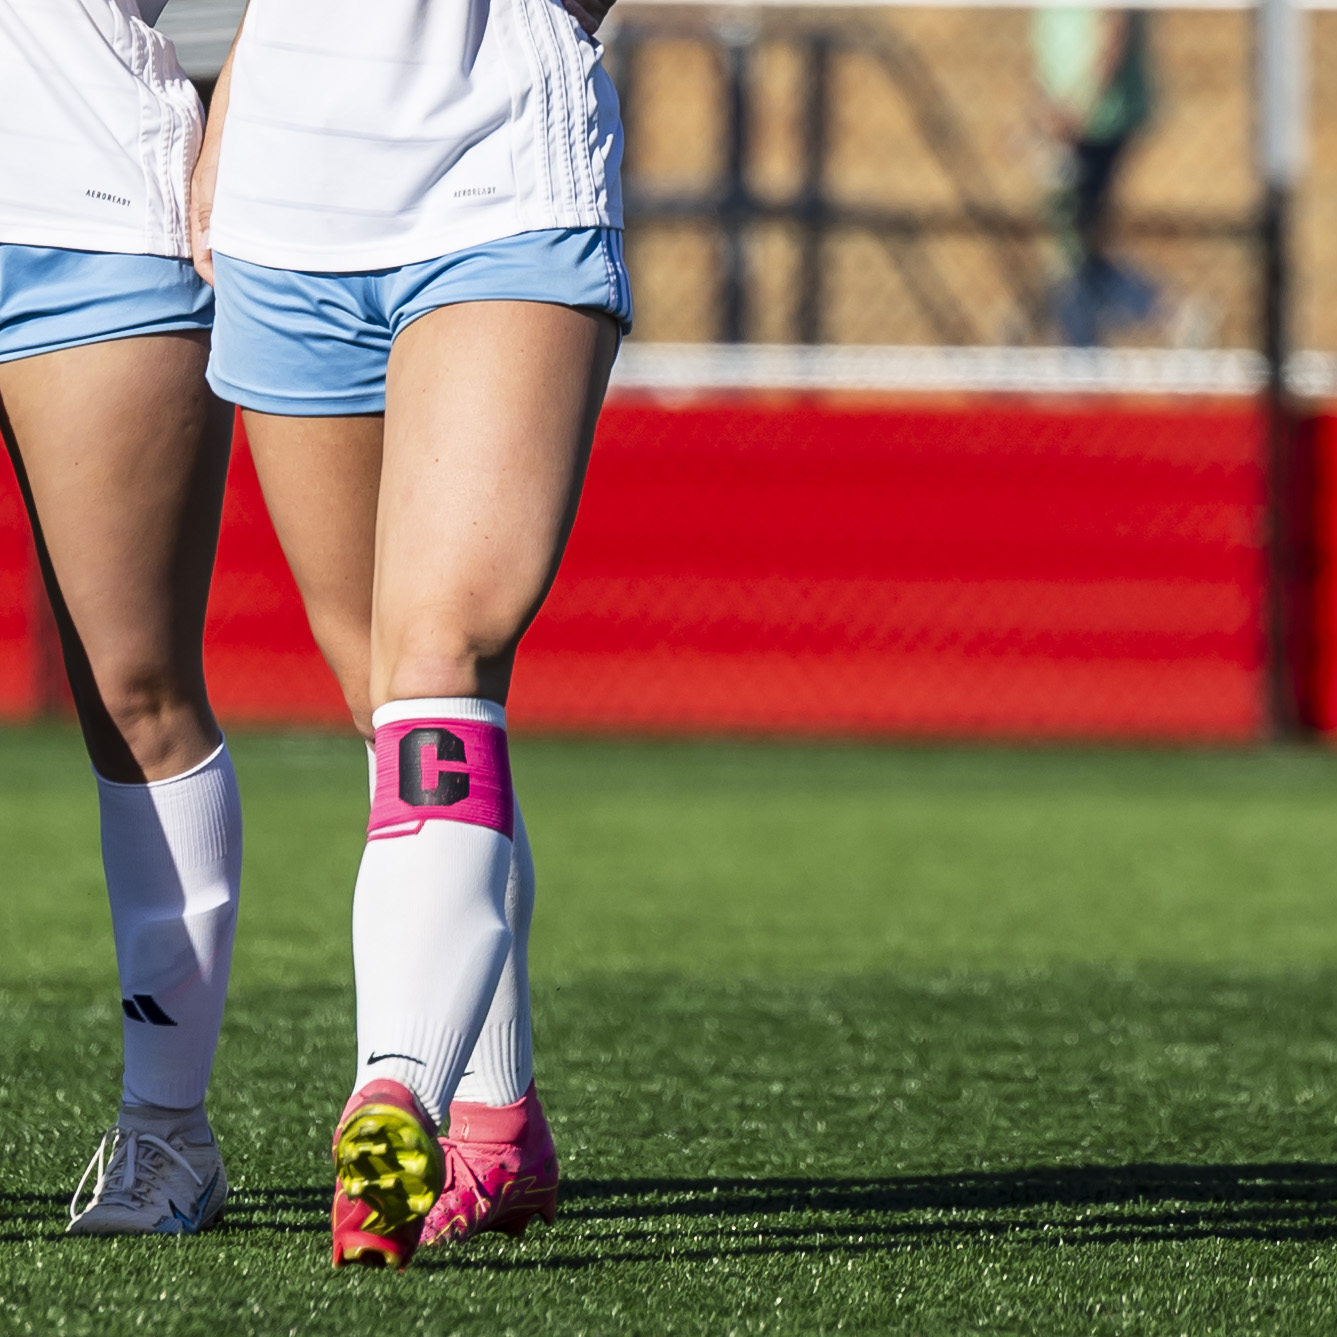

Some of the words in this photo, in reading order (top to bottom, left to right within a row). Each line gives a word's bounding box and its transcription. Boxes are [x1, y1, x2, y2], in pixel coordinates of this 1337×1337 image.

[85, 189, 131, 207] AEROREADY
[453, 186, 496, 198] AEROREADY
[398, 727, 470, 807] C
